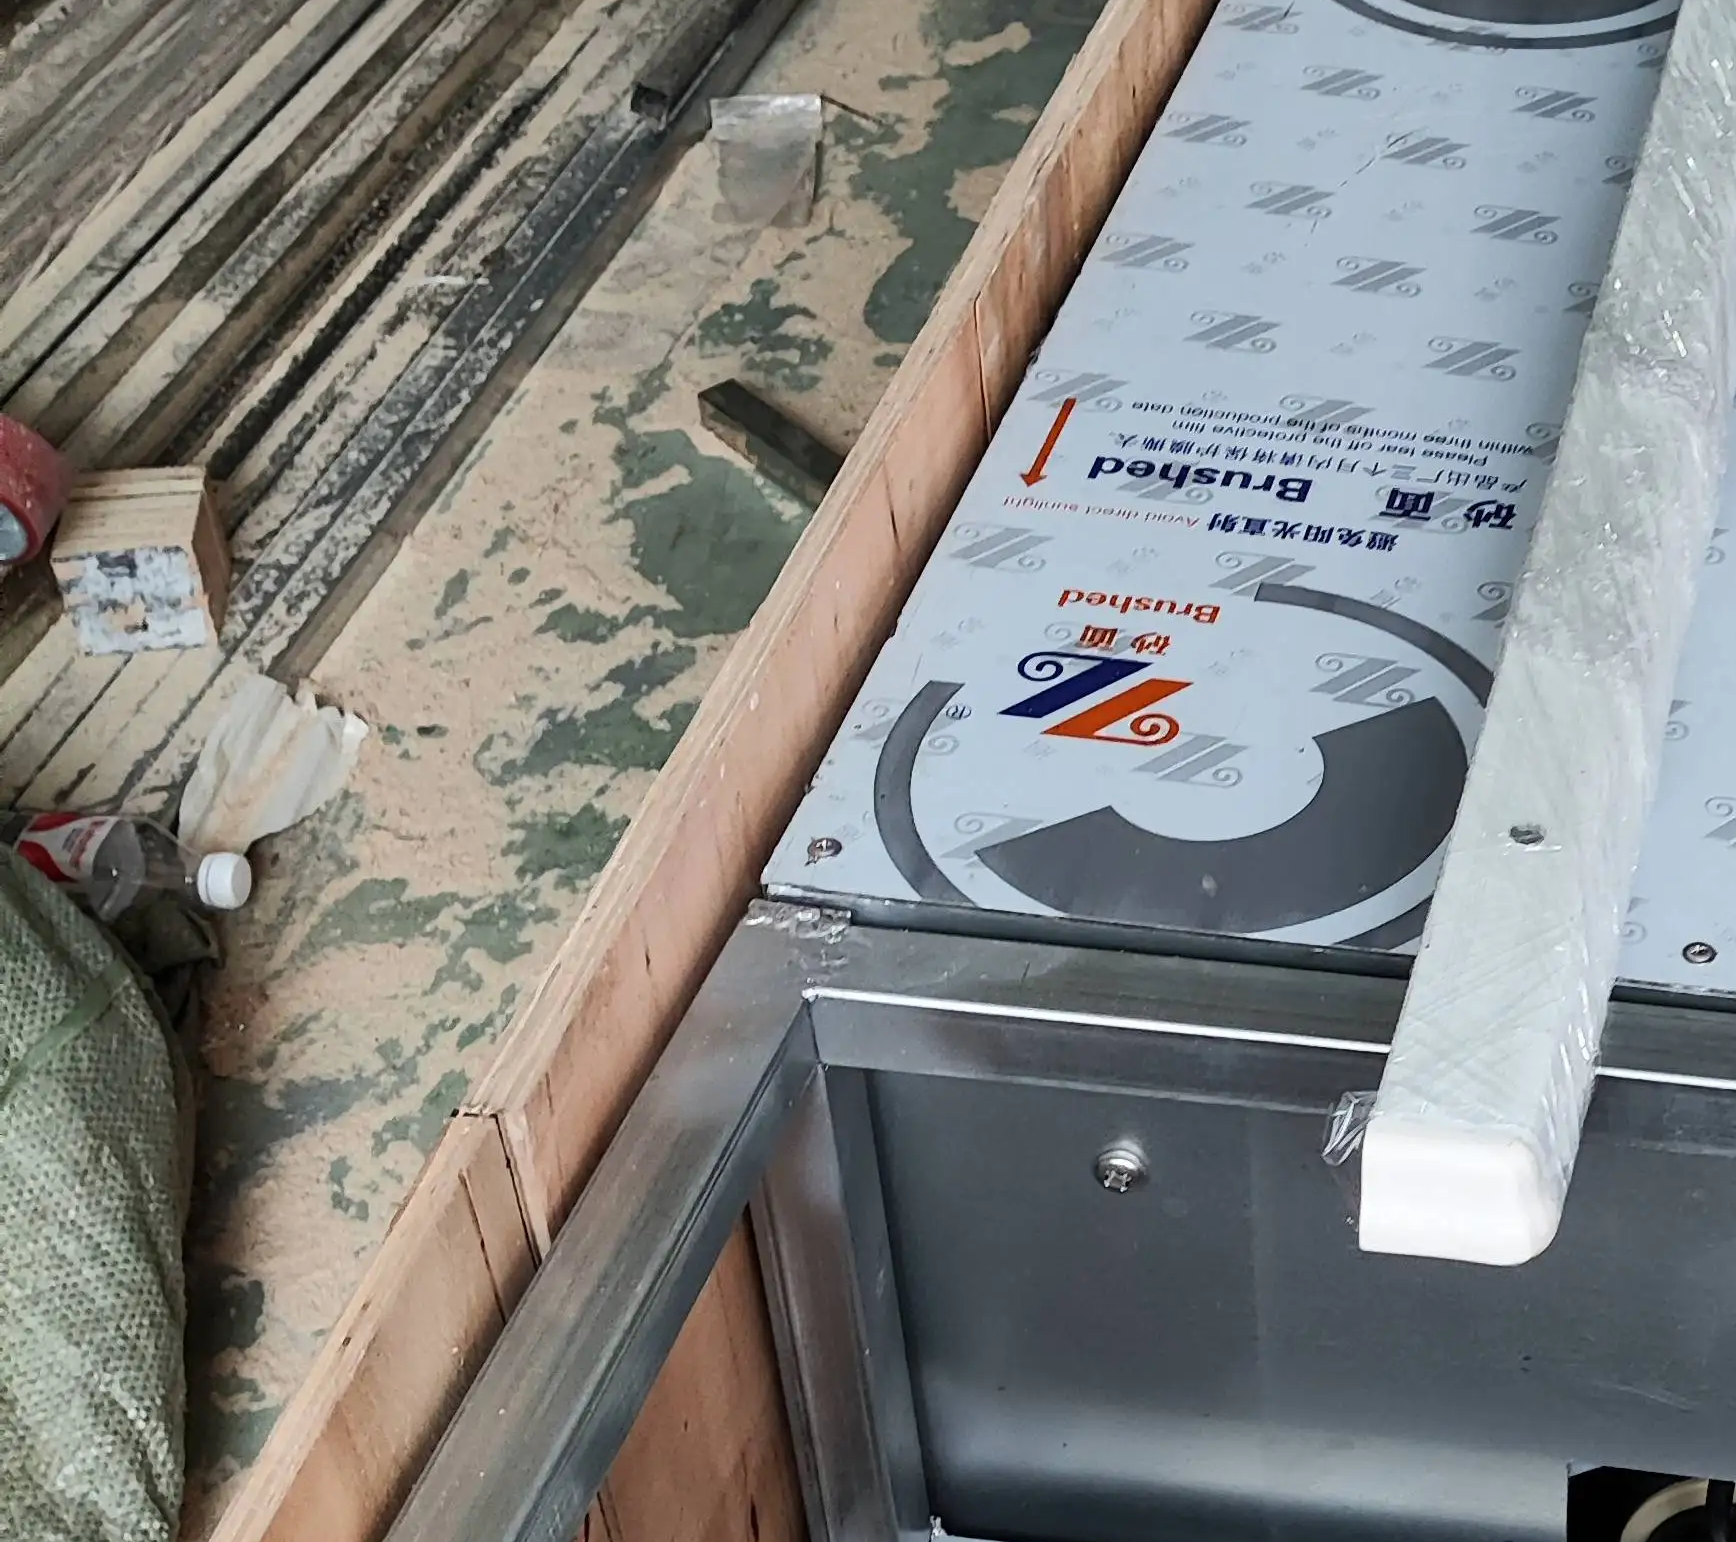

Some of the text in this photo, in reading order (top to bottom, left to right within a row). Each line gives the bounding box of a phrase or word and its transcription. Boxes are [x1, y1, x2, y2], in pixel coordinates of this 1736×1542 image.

[1131, 400, 1175, 416] date
[1179, 403, 1281, 427] production
[1171, 419, 1206, 435] film
[1212, 423, 1307, 444] protective
[1312, 433, 1342, 449] the
[1379, 443, 1416, 458] tear
[1423, 433, 1473, 450] three
[1421, 448, 1489, 468] Please
[1087, 455, 1519, 530] 砂面 Brushed
[1207, 512, 1400, 552] 避免阳光直射
[1057, 588, 1221, 625] Brushed
[1074, 624, 1173, 656] 砂面
